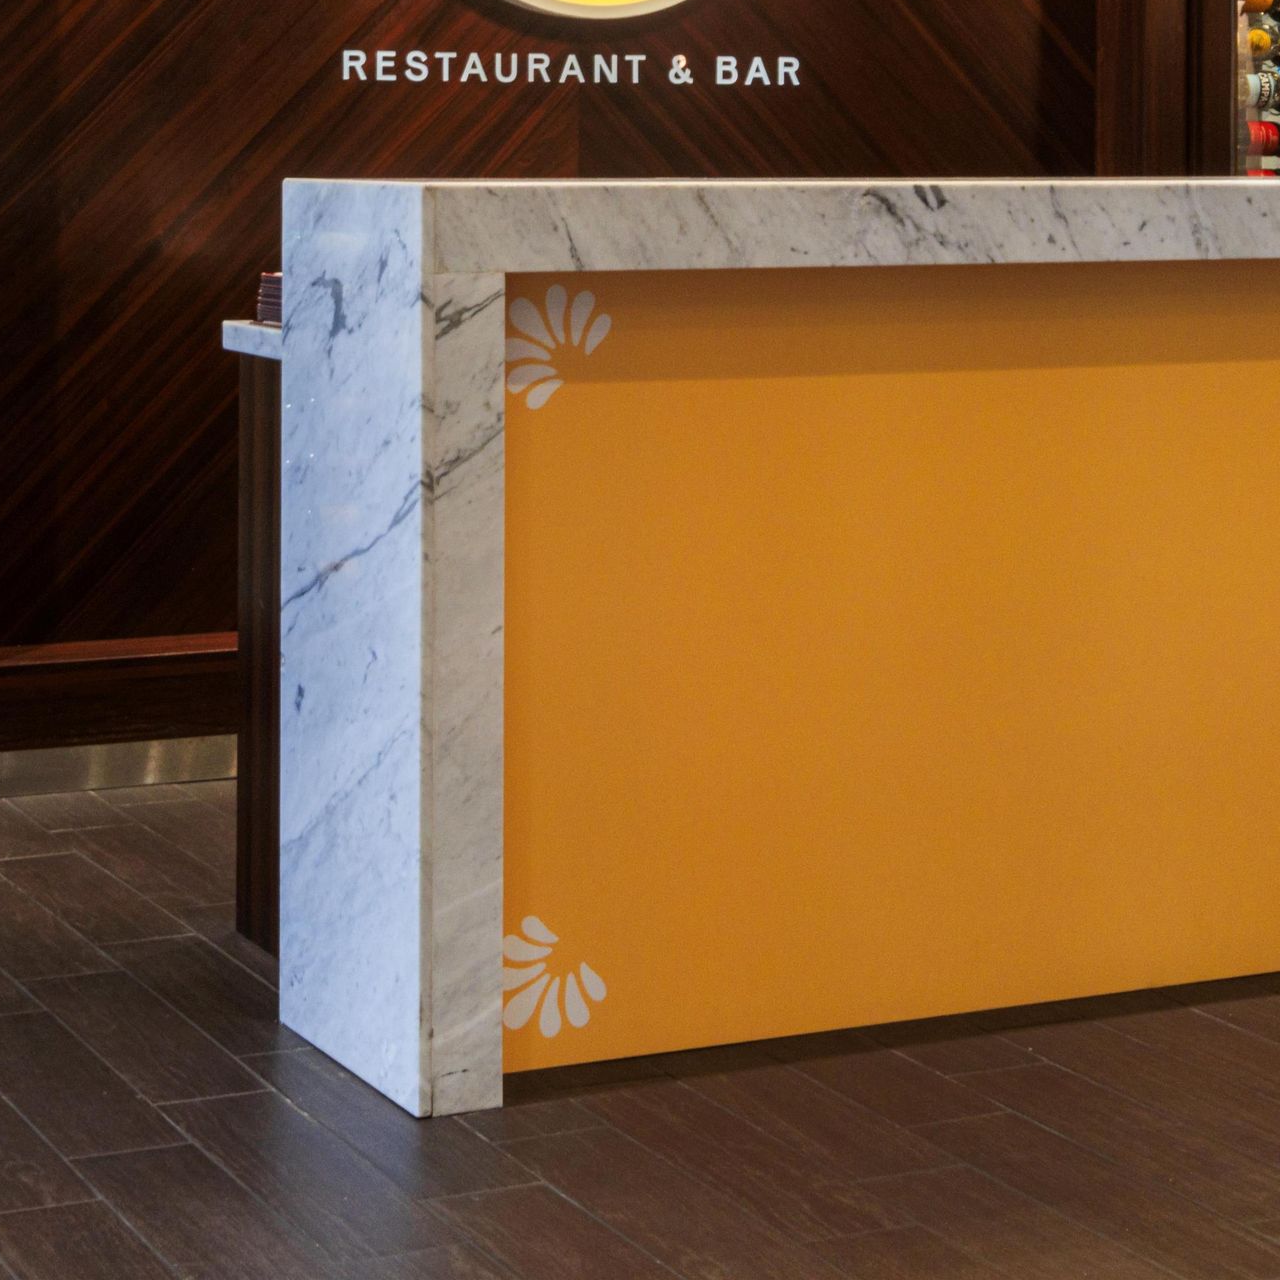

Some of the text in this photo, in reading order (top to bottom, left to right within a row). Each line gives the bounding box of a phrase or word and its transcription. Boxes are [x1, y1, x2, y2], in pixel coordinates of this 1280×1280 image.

[341, 49, 801, 87] RESTAURANT & BAR
